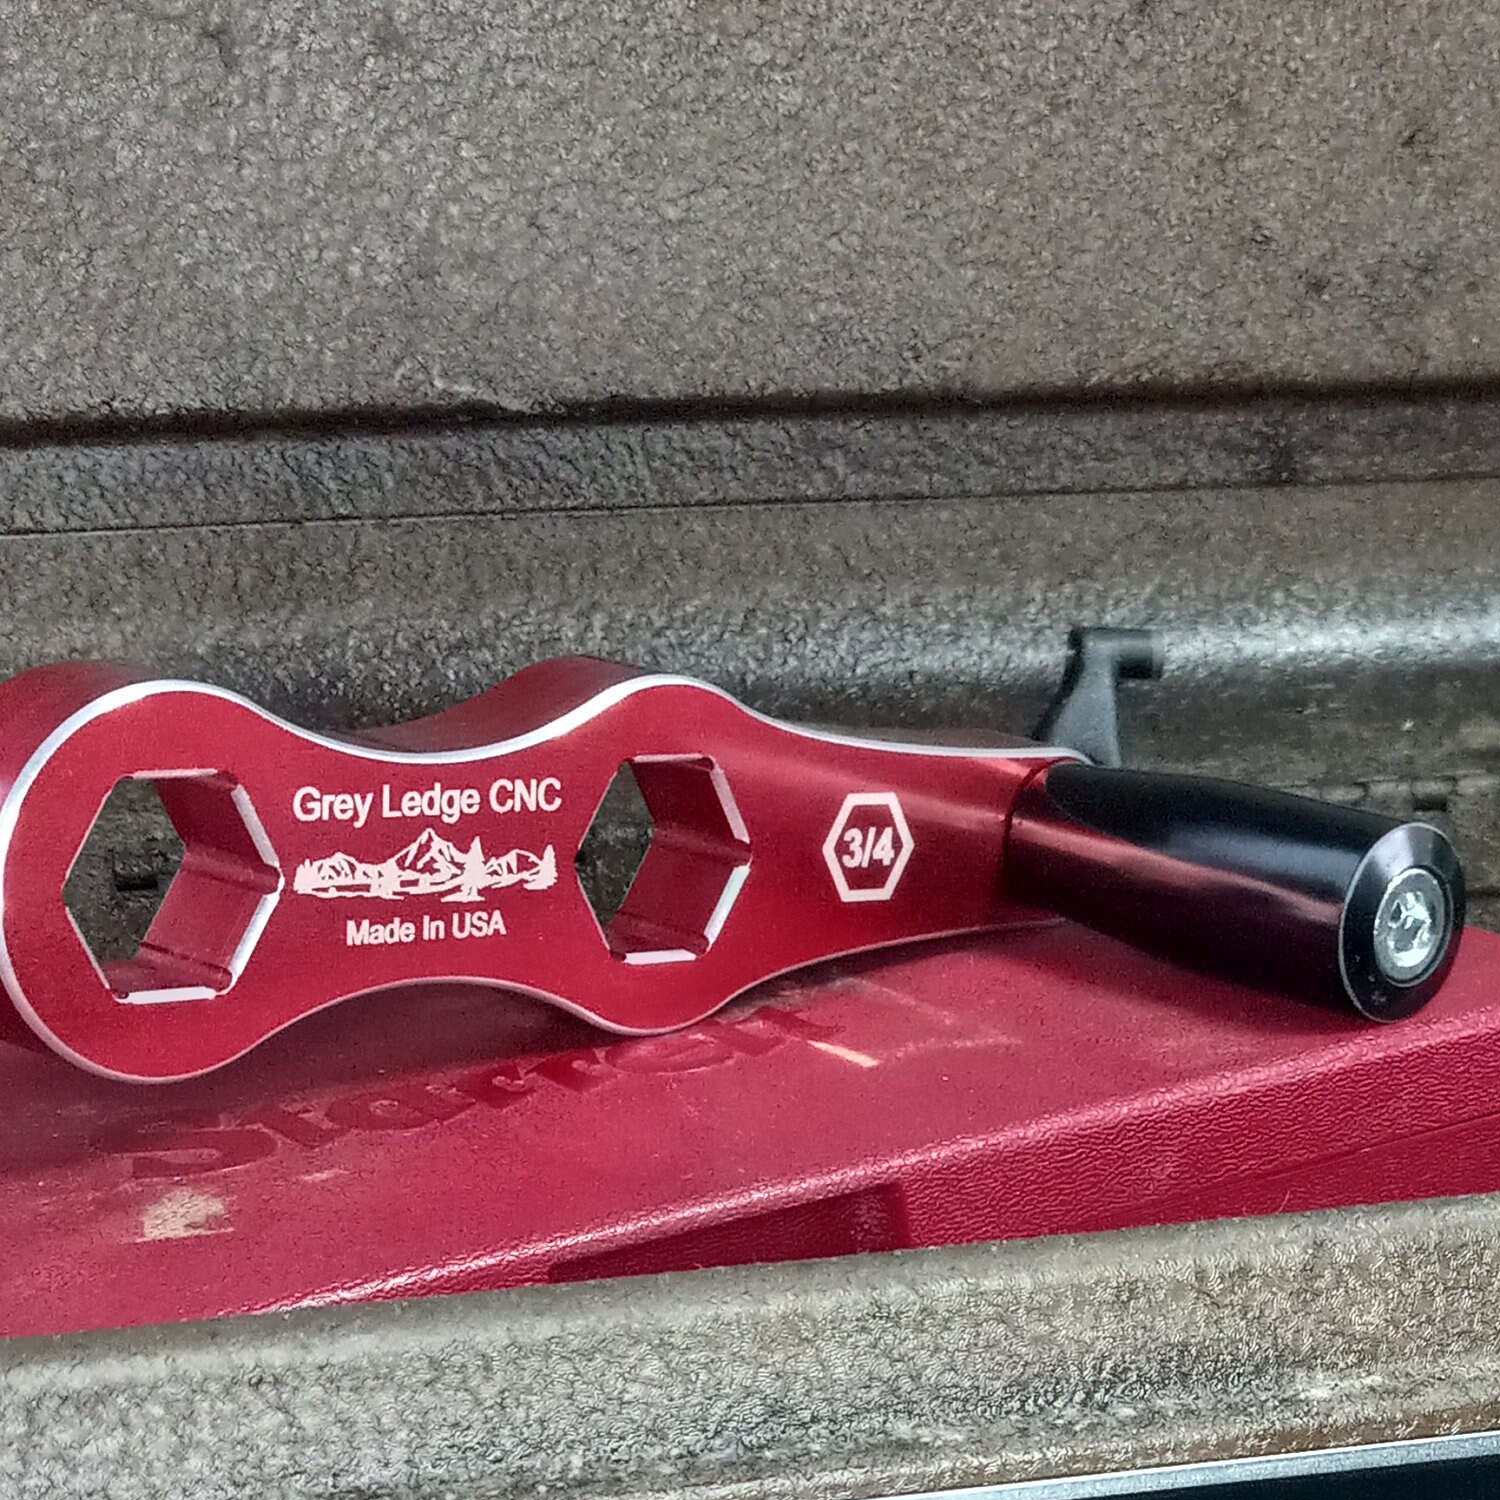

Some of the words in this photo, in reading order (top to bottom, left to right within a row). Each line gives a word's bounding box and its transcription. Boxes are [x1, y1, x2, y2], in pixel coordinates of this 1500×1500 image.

[292, 786, 374, 828] Grey
[382, 782, 481, 824] Ledge
[489, 777, 562, 814] CNC
[842, 826, 896, 868] 3/4
[346, 917, 416, 946] Made
[422, 915, 445, 941] In
[452, 909, 507, 939] USA
